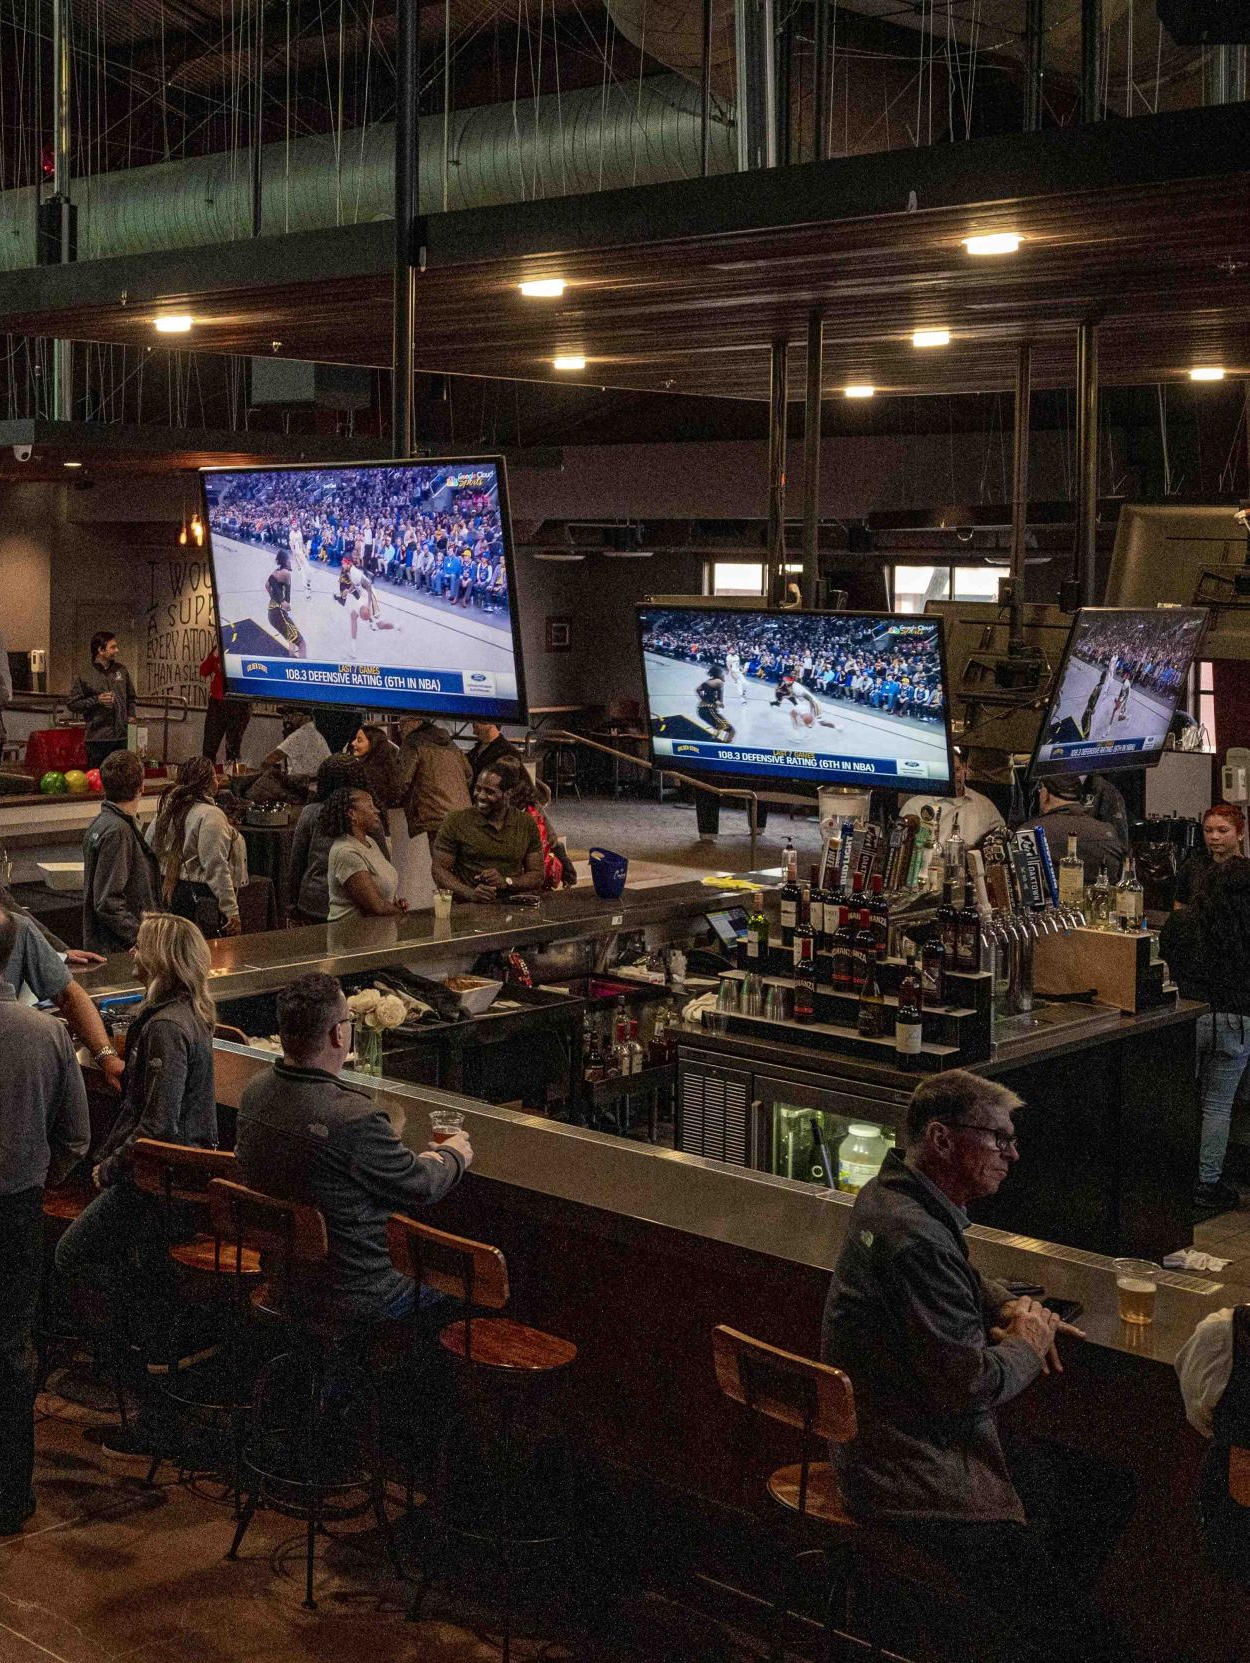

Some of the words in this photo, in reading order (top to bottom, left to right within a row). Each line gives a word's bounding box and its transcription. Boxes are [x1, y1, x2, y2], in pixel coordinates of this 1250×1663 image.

[169, 561, 212, 598] WOU
[147, 662, 173, 693] THAN
[175, 664, 181, 682] A
[285, 669, 307, 681] 108.3
[308, 670, 350, 684] DEFENSIVE
[352, 673, 383, 687] RATING
[385, 675, 405, 688] (6TH
[407, 678, 417, 689] IN
[418, 679, 441, 692] NBA)
[338, 664, 352, 673] LAST
[359, 666, 380, 675] GAMES
[718, 750, 740, 760] 108.3
[742, 752, 784, 764] DEFENSIVE
[786, 757, 817, 767] RATING
[819, 759, 840, 769] (6TH
[842, 761, 851, 770] IN
[853, 762, 875, 773] NBA)
[794, 751, 815, 759] GAMES
[843, 835, 853, 865] LIGHT
[840, 865, 849, 885] BUD
[1028, 866, 1040, 901] OAKTOWN
